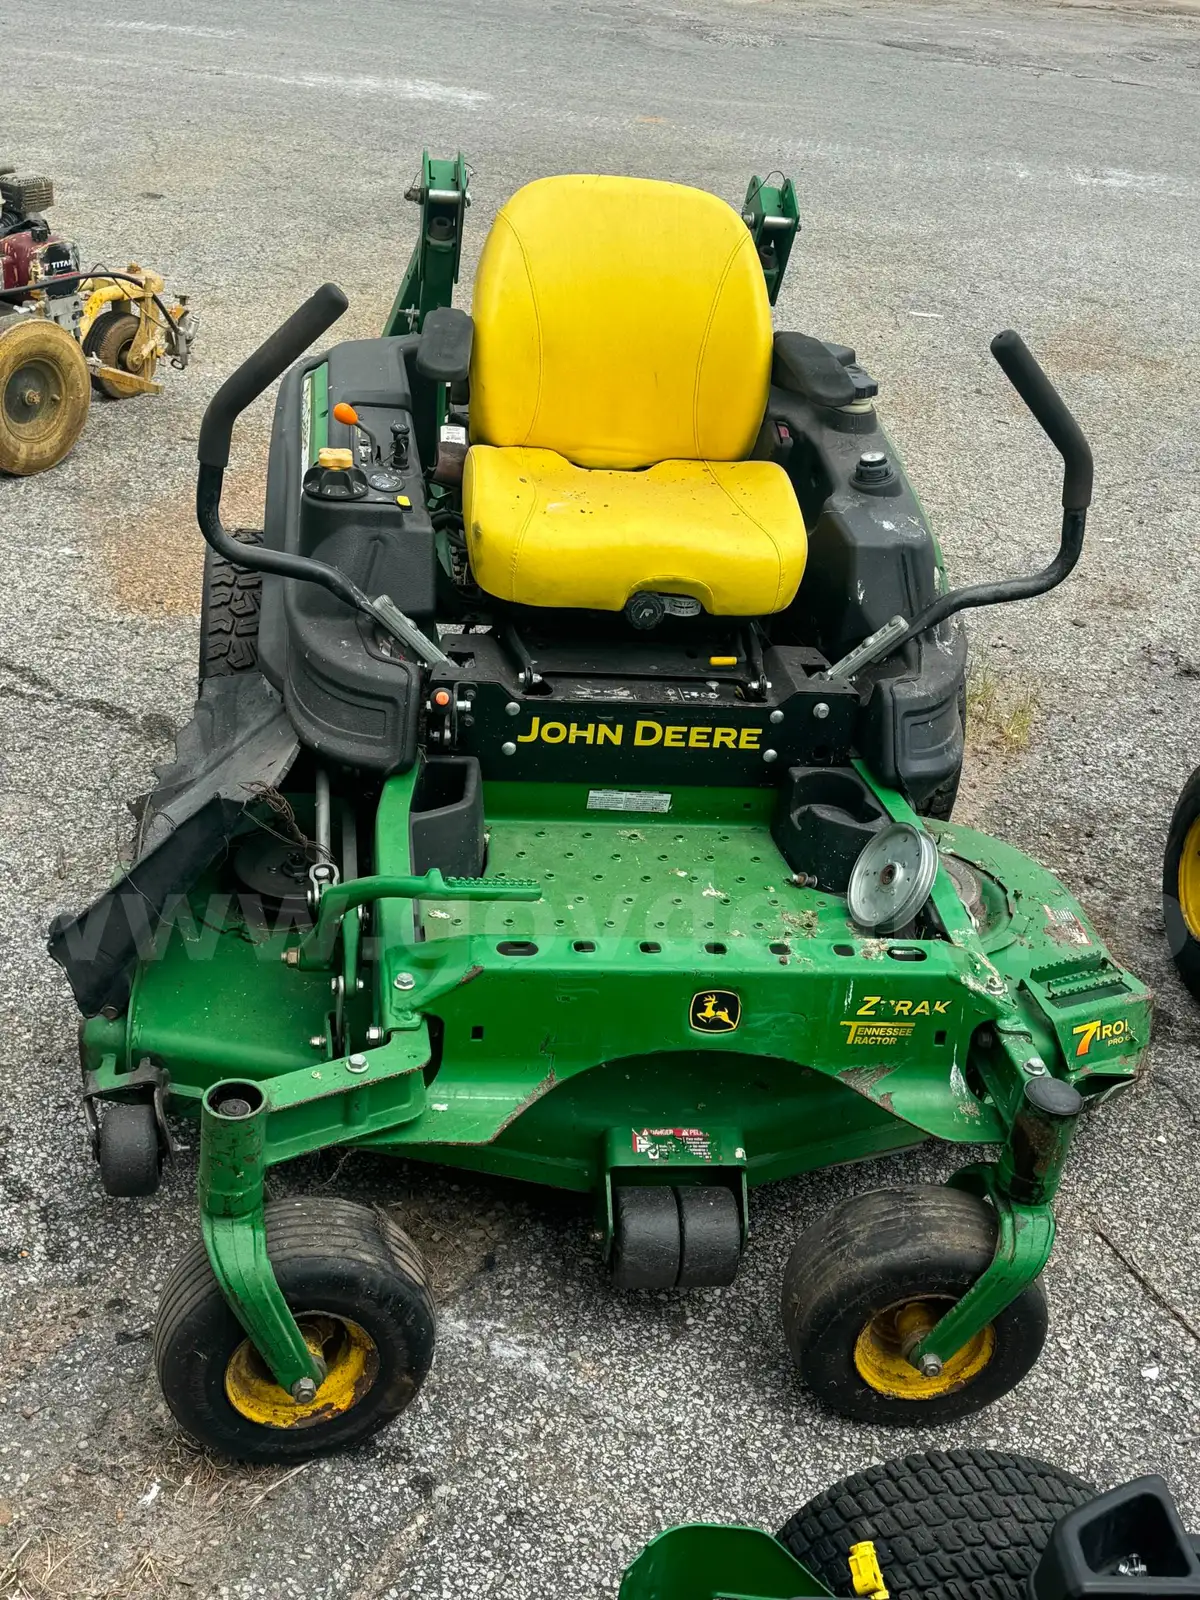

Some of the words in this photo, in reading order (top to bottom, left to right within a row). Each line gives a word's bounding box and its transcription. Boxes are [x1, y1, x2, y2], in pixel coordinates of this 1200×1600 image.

[517, 717, 623, 746] JOHN
[634, 720, 763, 749] DEERE
[840, 1021, 915, 1040] TENNESSEE
[1107, 1036, 1124, 1047] PRO
